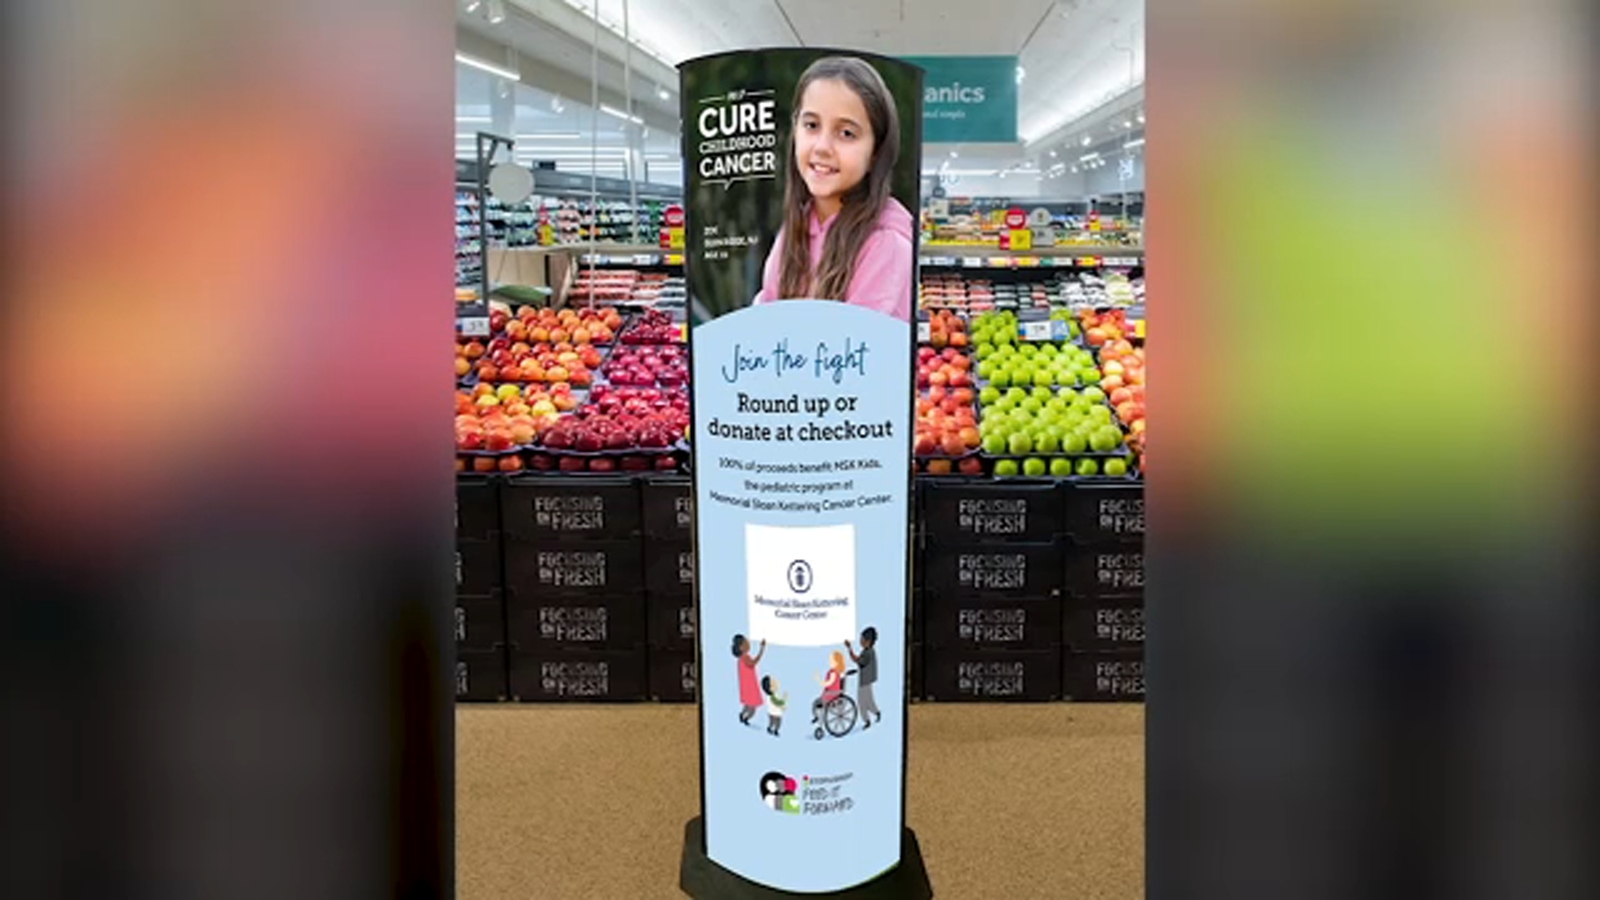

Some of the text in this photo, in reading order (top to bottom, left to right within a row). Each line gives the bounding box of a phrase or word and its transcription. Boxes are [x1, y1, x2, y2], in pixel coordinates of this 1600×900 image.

[699, 101, 775, 138] CURE
[699, 134, 776, 155] CHILDHOOD
[699, 151, 776, 178] CANCER
[722, 337, 870, 385] Join the fight
[737, 393, 858, 418] Round up or
[708, 418, 894, 441] donate at checkout
[719, 457, 743, 470] 100%
[745, 459, 755, 471] of
[756, 463, 798, 474] proceeds
[745, 479, 759, 490] the
[760, 481, 801, 493] pediatric
[801, 481, 841, 494] program
[822, 498, 856, 511] Cancer
[551, 512, 604, 530] FRESH
[974, 515, 1026, 533] FRESH
[554, 568, 607, 587] FRESH
[974, 569, 1025, 588] FRESH
[556, 623, 607, 641] FRESH
[974, 624, 1024, 642] FRESH
[558, 677, 609, 696] FRESH
[974, 677, 1023, 696] FRESH
